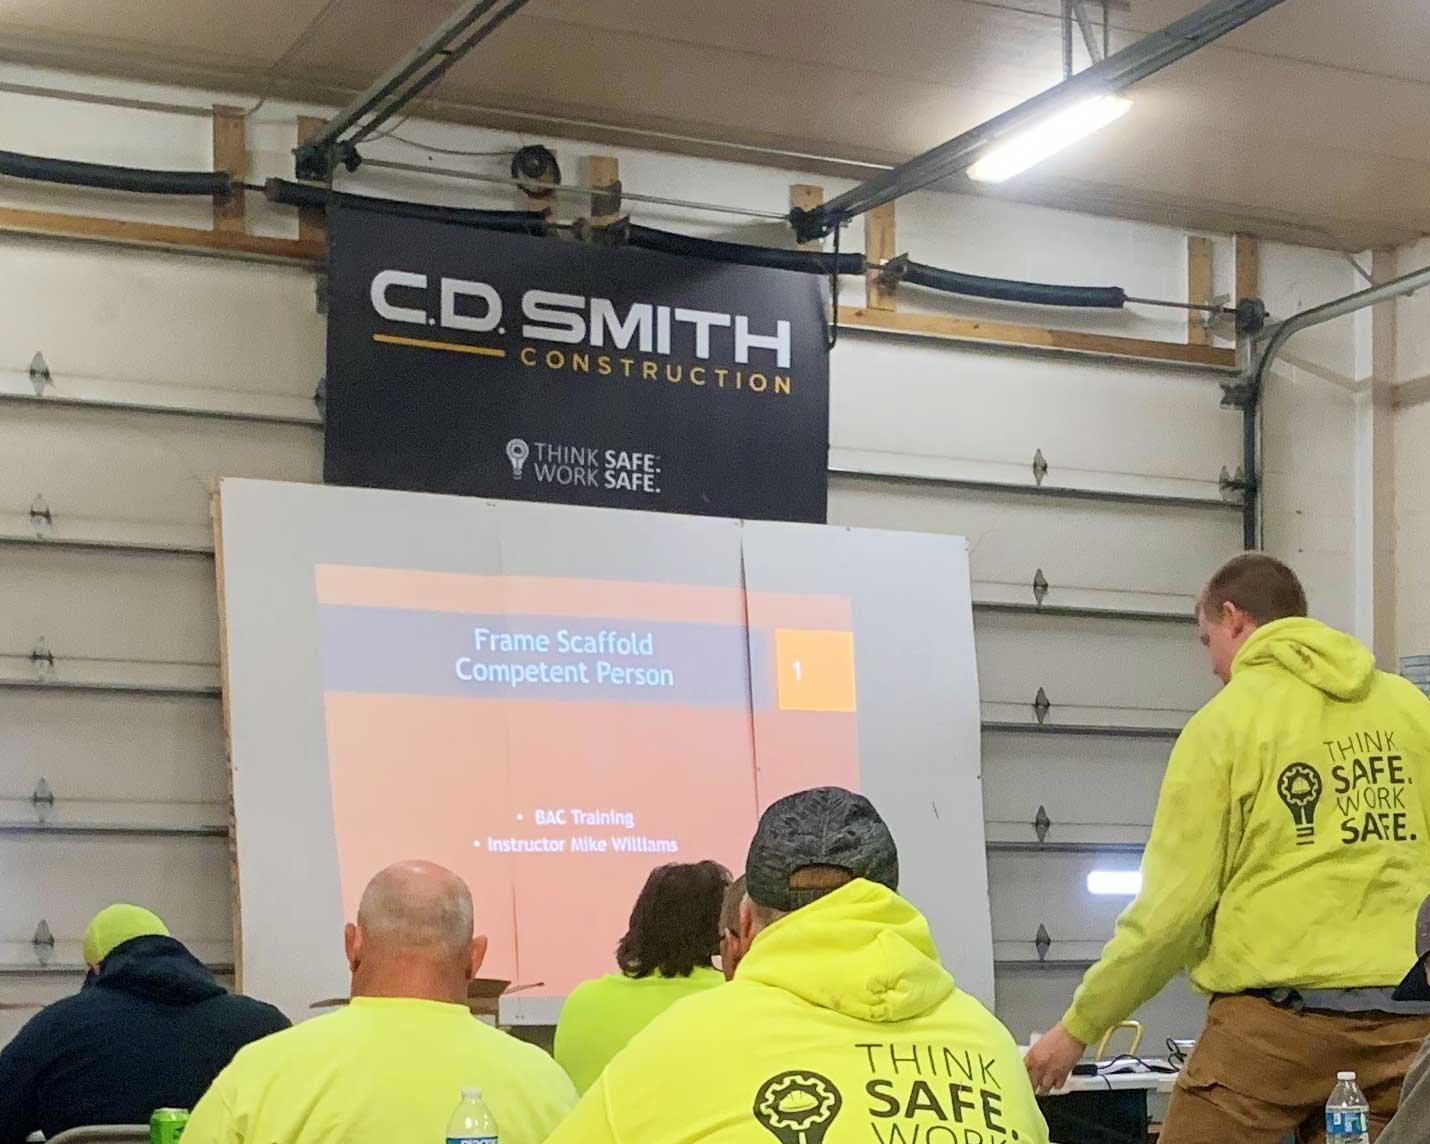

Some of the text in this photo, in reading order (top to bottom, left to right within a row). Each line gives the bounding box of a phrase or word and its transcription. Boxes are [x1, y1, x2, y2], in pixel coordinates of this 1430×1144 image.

[522, 289, 791, 369] SMITH
[520, 346, 792, 395] CONSTRUCTION
[534, 441, 662, 474] THINK SAFE.
[534, 462, 662, 493] WORK SAFE.
[474, 627, 654, 656] Frame Scaffold
[455, 657, 674, 688] Competent Person
[792, 660, 802, 681] 1
[1322, 730, 1399, 763] THINK
[1331, 755, 1413, 794] SAFE.
[1336, 787, 1406, 817] WORK
[534, 808, 635, 829] BAC Training
[1341, 812, 1417, 844] SAFE.
[487, 836, 679, 853] Instructor Mike Williams
[854, 1043, 1002, 1090] THINK
[865, 1079, 1019, 1141] SAFE.
